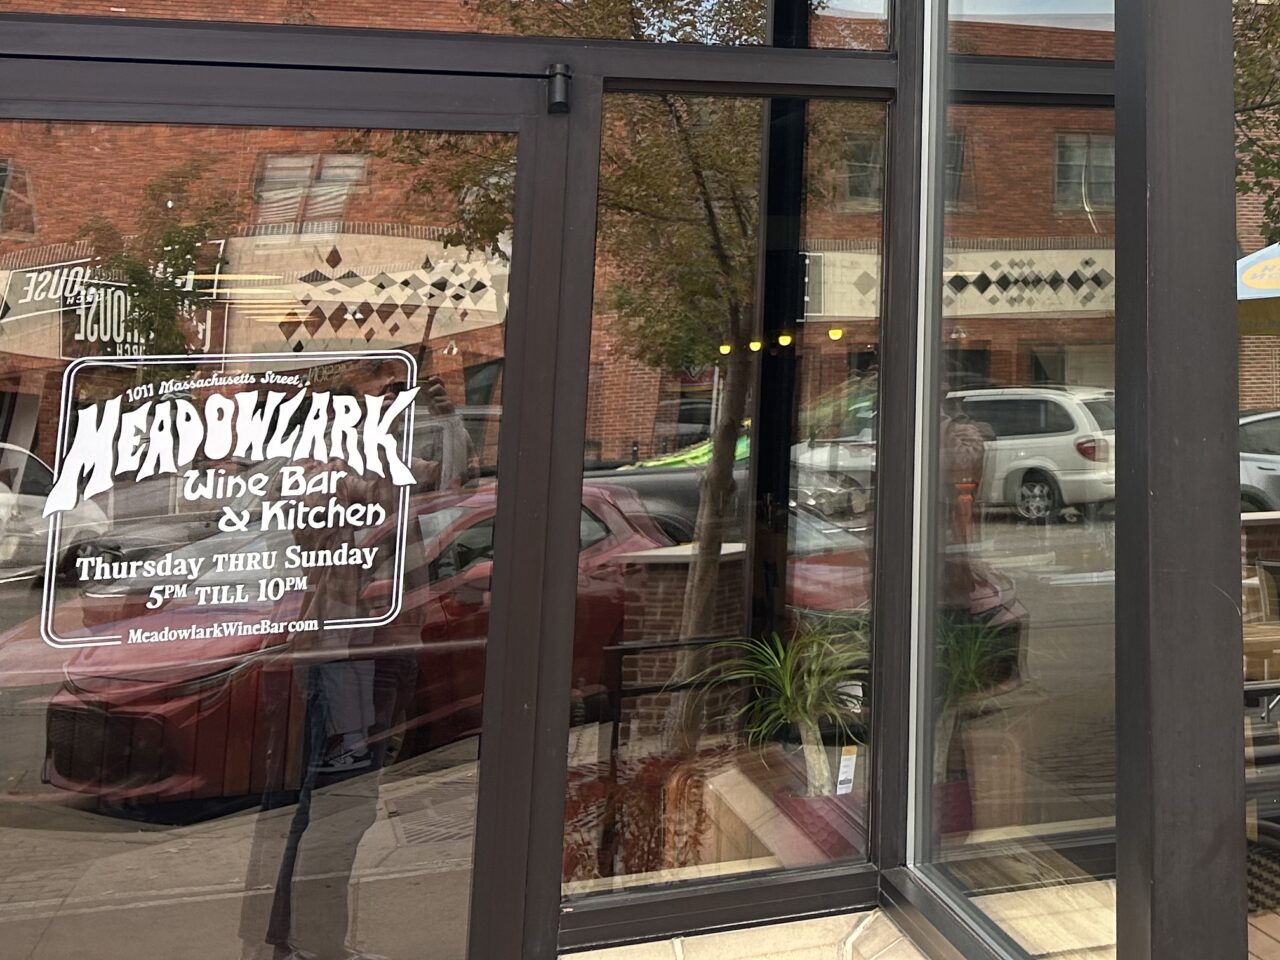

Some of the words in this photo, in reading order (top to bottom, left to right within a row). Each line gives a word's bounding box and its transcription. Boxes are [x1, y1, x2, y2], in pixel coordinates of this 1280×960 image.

[126, 383, 155, 403] 1011
[158, 372, 255, 396] Massachusetts
[42, 386, 420, 518] MEADOWLARK
[183, 468, 269, 501] Wine
[279, 465, 348, 497] Bar
[217, 506, 250, 532] &
[260, 496, 386, 531] Kitchen
[75, 553, 204, 581] Thursday
[212, 551, 276, 573] THRU
[284, 542, 379, 570] Sunday
[145, 583, 188, 609] 5PM
[195, 584, 249, 606] TILL
[256, 576, 308, 602] 10PM
[127, 619, 319, 644] MeadowlarkWineBarcom
